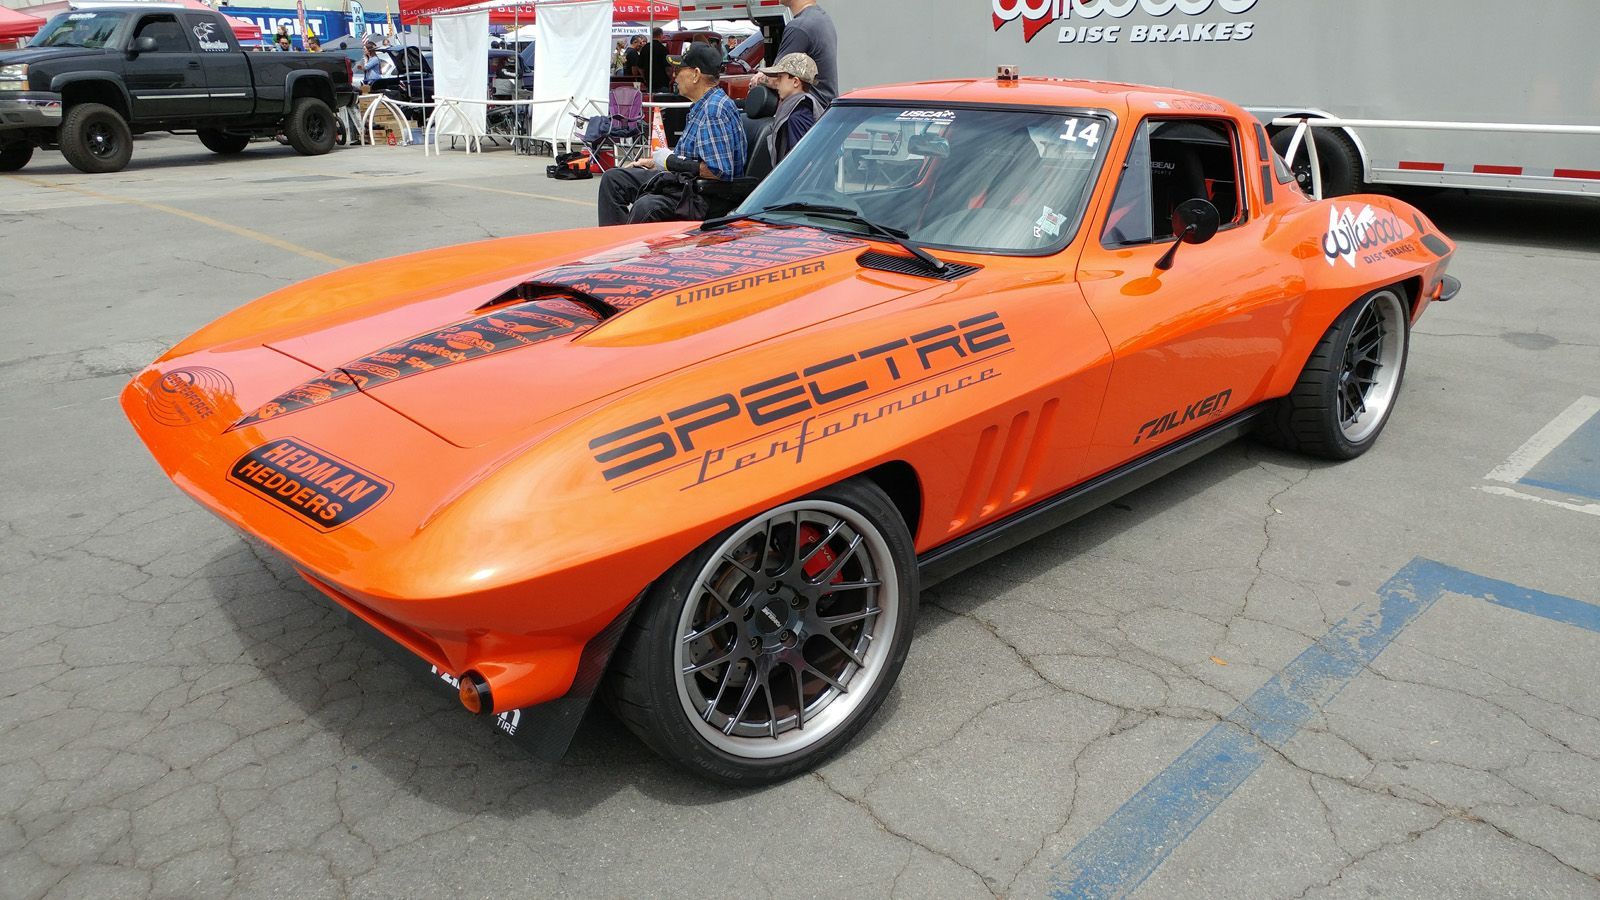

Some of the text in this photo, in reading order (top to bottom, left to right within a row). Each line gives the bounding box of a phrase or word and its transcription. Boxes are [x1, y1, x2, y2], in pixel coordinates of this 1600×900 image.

[1058, 22, 1255, 43] DISC BRAKES
[1059, 118, 1101, 147] 14
[1363, 244, 1415, 264] DISC BRAKES
[676, 260, 825, 306] LINGENFELTER
[589, 311, 1011, 481] SPECTRE
[1133, 388, 1232, 445] FALKEN
[238, 459, 344, 521] HEDDERS
[260, 442, 379, 503] HEDMAN
[497, 717, 518, 736] TIRE
